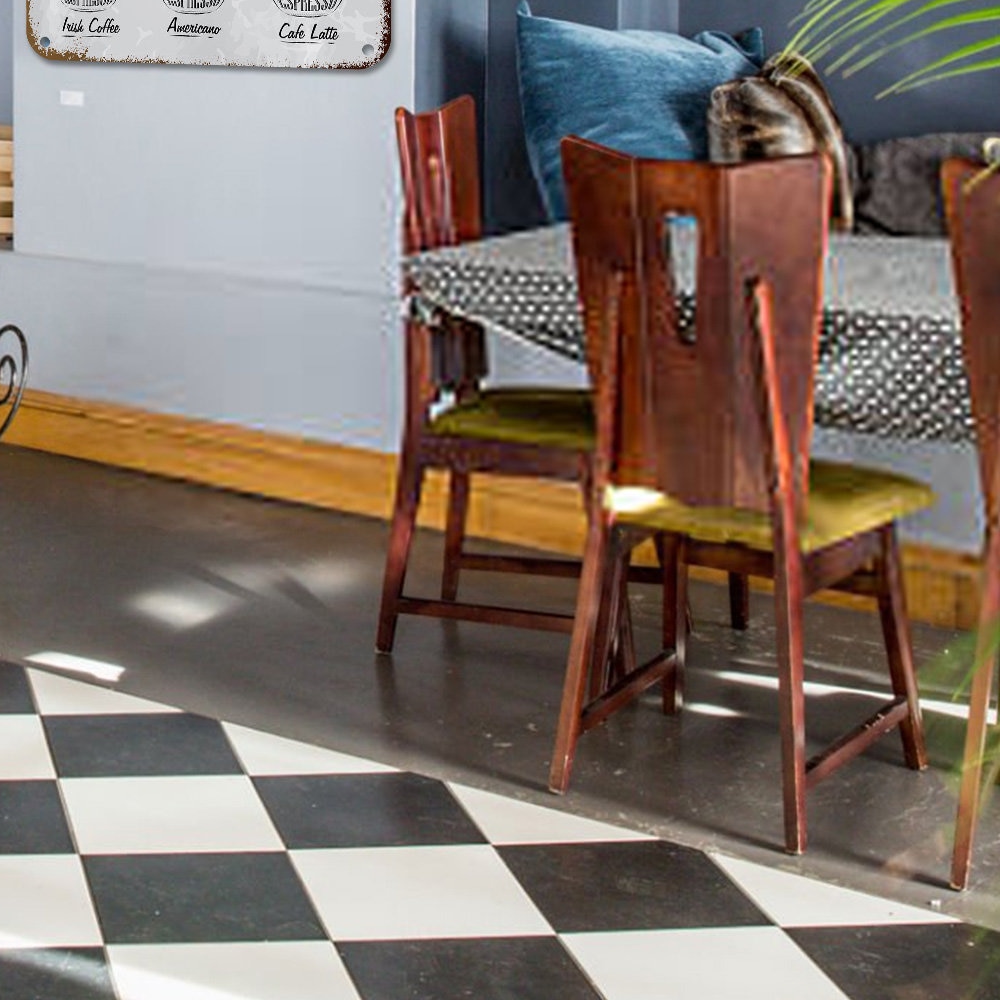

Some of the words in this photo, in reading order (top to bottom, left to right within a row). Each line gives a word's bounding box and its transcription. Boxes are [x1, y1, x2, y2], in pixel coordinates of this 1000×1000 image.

[62, 17, 84, 32] Irish
[88, 17, 120, 33] Coffee
[167, 17, 221, 34] Americano
[279, 22, 306, 39] Cafe
[310, 23, 339, 40] Latte
